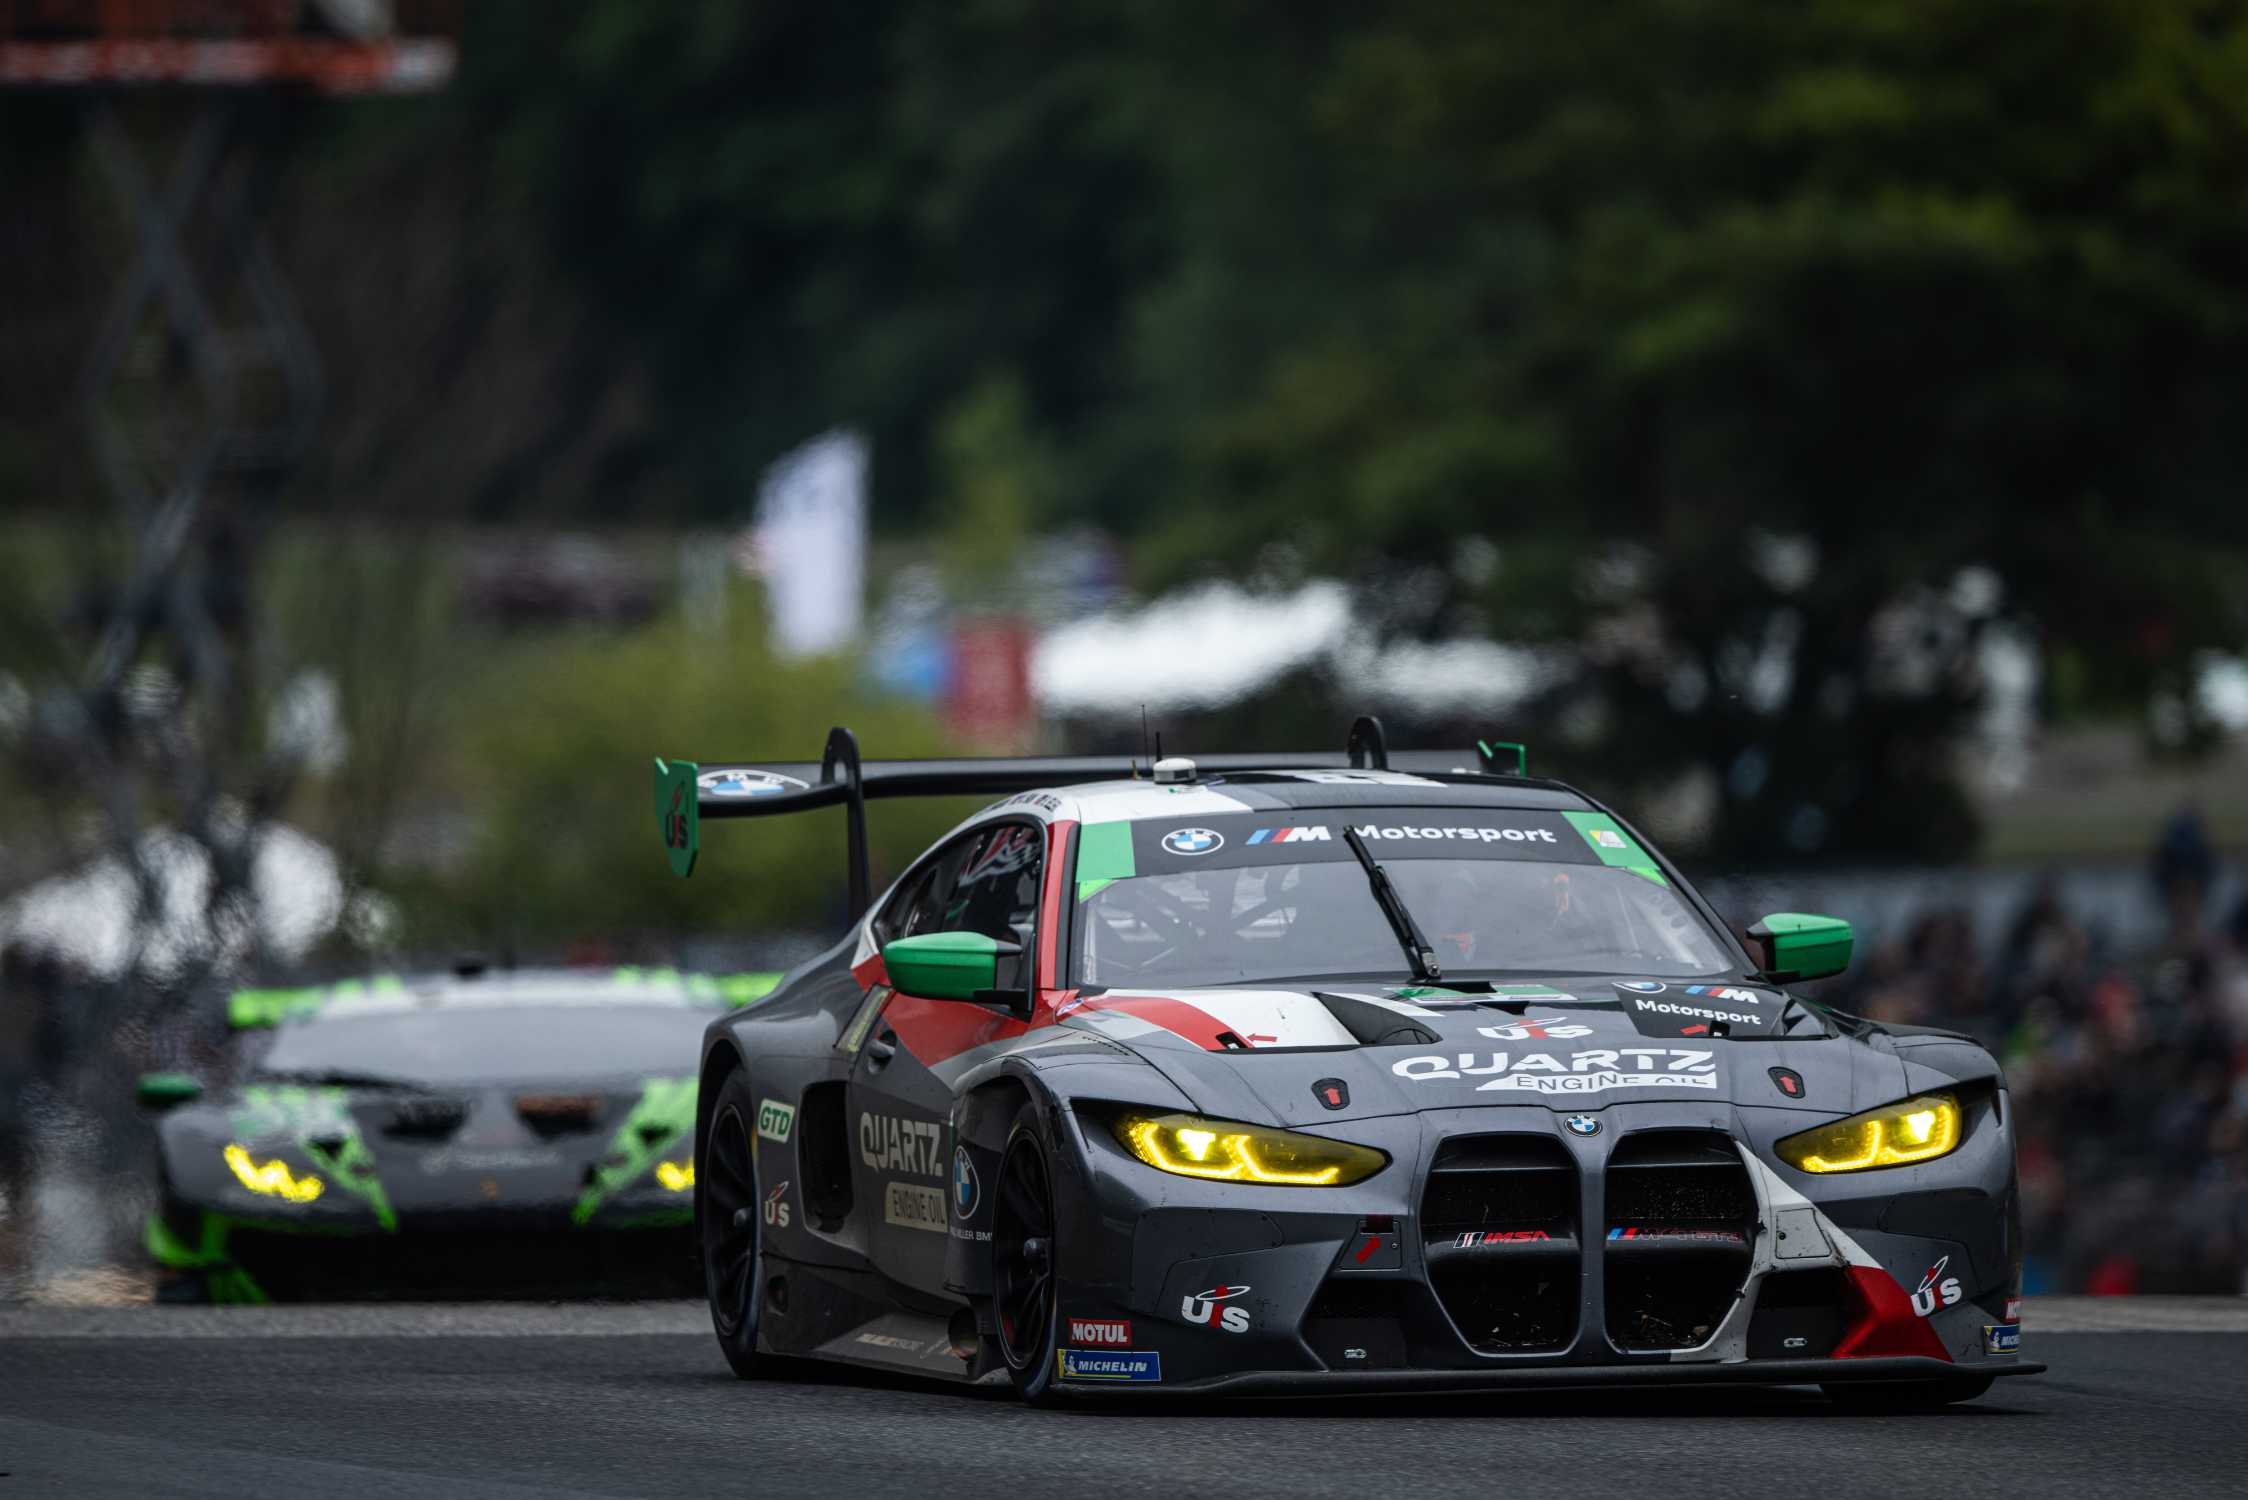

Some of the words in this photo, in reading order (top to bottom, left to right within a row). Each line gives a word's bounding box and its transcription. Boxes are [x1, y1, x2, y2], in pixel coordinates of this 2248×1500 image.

[1353, 824, 1557, 843] Motorsport
[1635, 999, 1761, 1025] Motorsport
[1392, 1049, 1716, 1080] QUARTZ
[759, 1106, 791, 1136] GTD
[860, 1112, 944, 1177] QUARTZ
[892, 1189, 928, 1221] ENGINE
[928, 1194, 946, 1224] OIL
[1483, 1230, 1551, 1245] IMSA
[1072, 1323, 1128, 1343] MOTUL
[1078, 1360, 1148, 1372] MICHELIN
